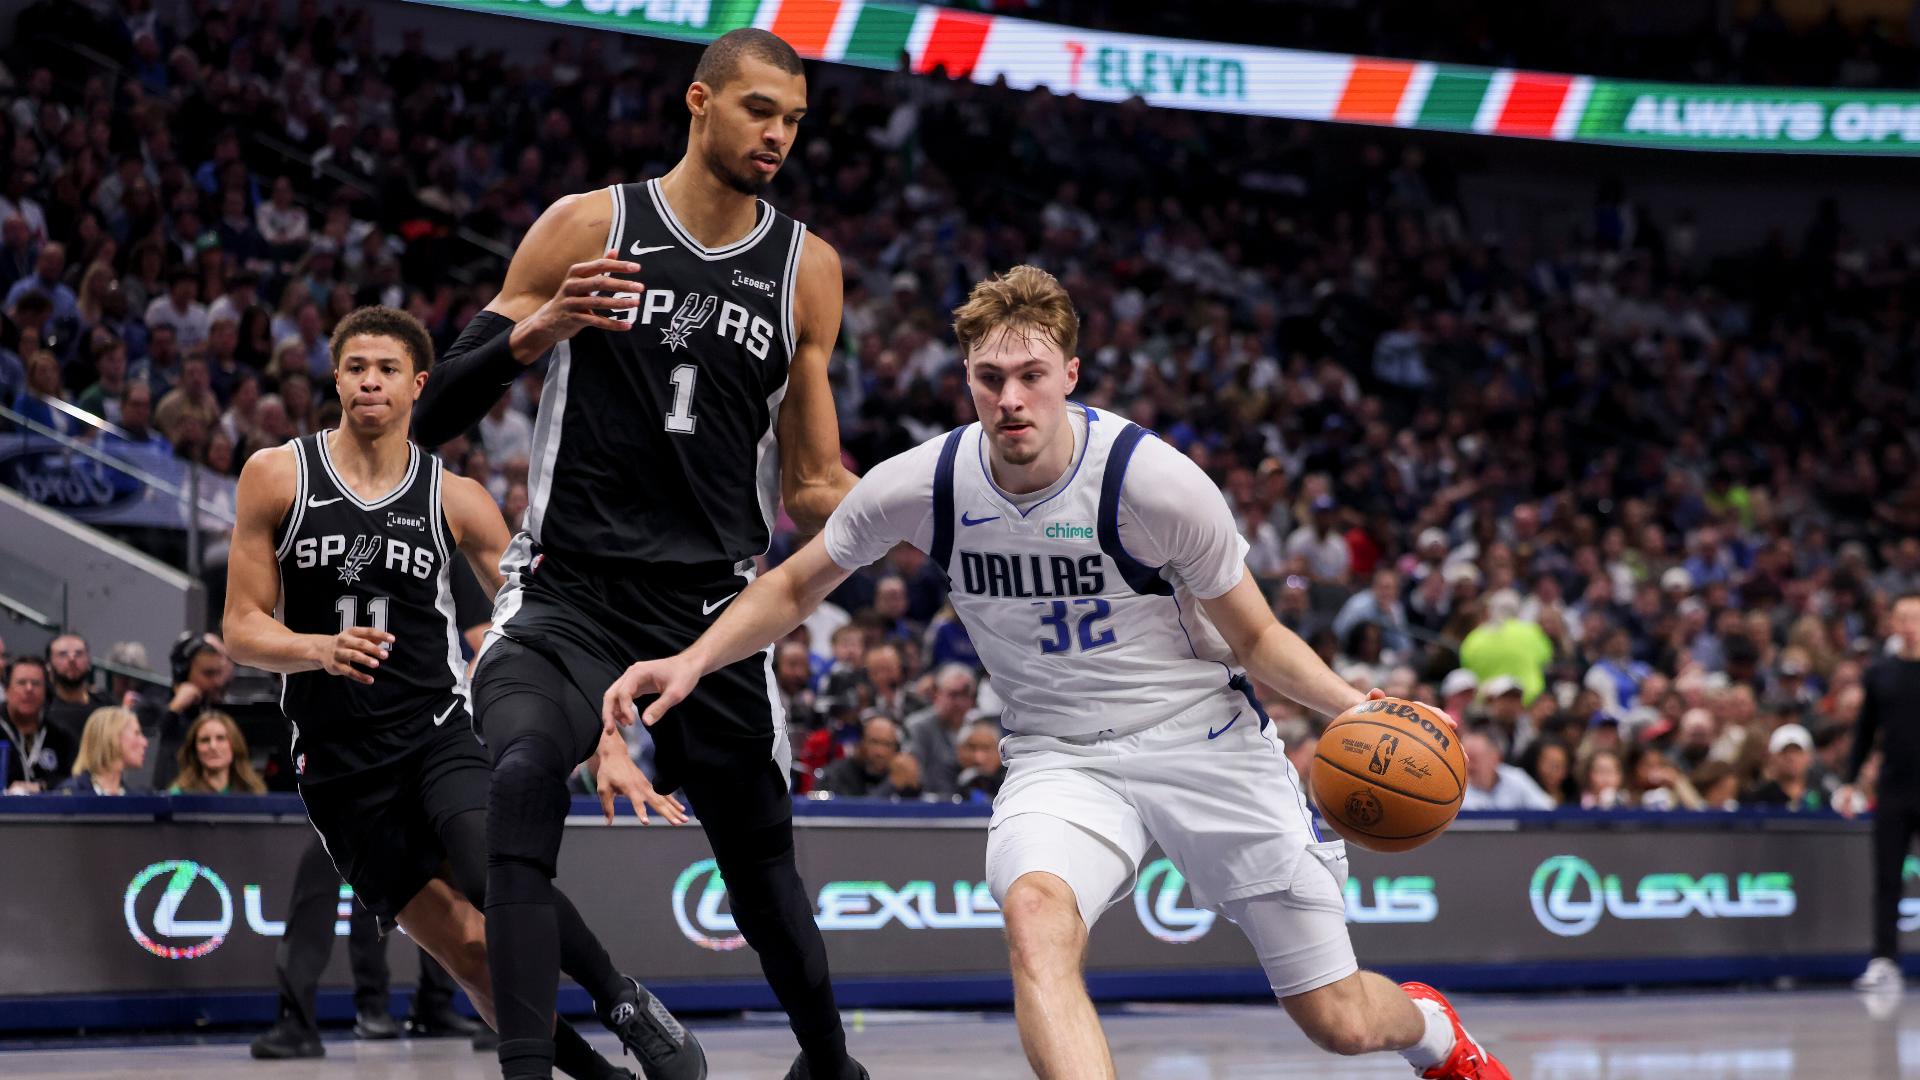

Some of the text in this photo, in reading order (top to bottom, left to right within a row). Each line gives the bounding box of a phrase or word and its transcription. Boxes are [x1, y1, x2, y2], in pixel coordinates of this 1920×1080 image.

[1625, 95, 1824, 142] ALWAYS
[738, 275, 771, 292] LEDGER
[664, 363, 698, 434] 1
[1045, 522, 1094, 539] chime
[295, 534, 434, 586] SPURS
[960, 551, 1106, 598] DALLAS
[335, 594, 393, 652] 11
[1031, 598, 1118, 656] 32
[814, 880, 1006, 930] EXUS
[1604, 872, 1797, 919] LEXUS
